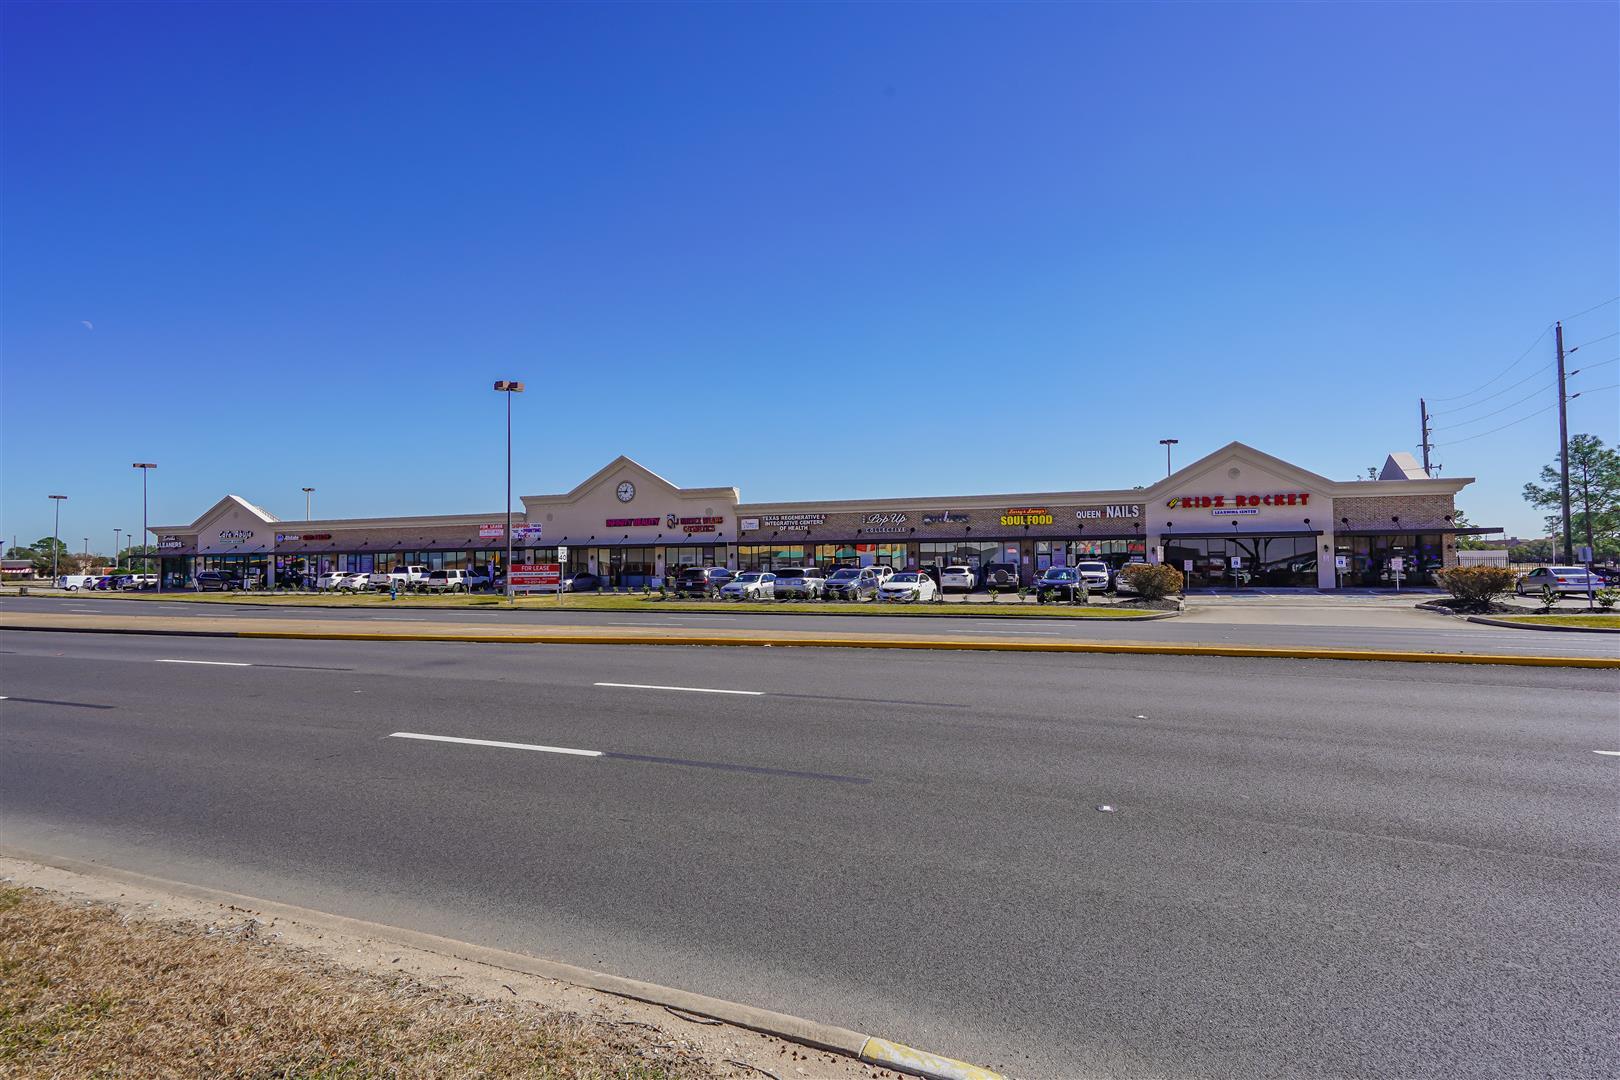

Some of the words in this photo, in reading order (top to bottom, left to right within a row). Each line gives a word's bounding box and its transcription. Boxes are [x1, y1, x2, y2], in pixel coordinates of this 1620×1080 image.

[1181, 495, 1225, 508] KIDZ
[1235, 493, 1310, 506] ROCKET
[1076, 510, 1101, 519] QUEEN
[1106, 505, 1139, 518] NAILS
[866, 513, 889, 526] Pop
[891, 513, 906, 525] Up
[1001, 516, 1026, 526] SOUL
[1027, 515, 1053, 525] FOOD
